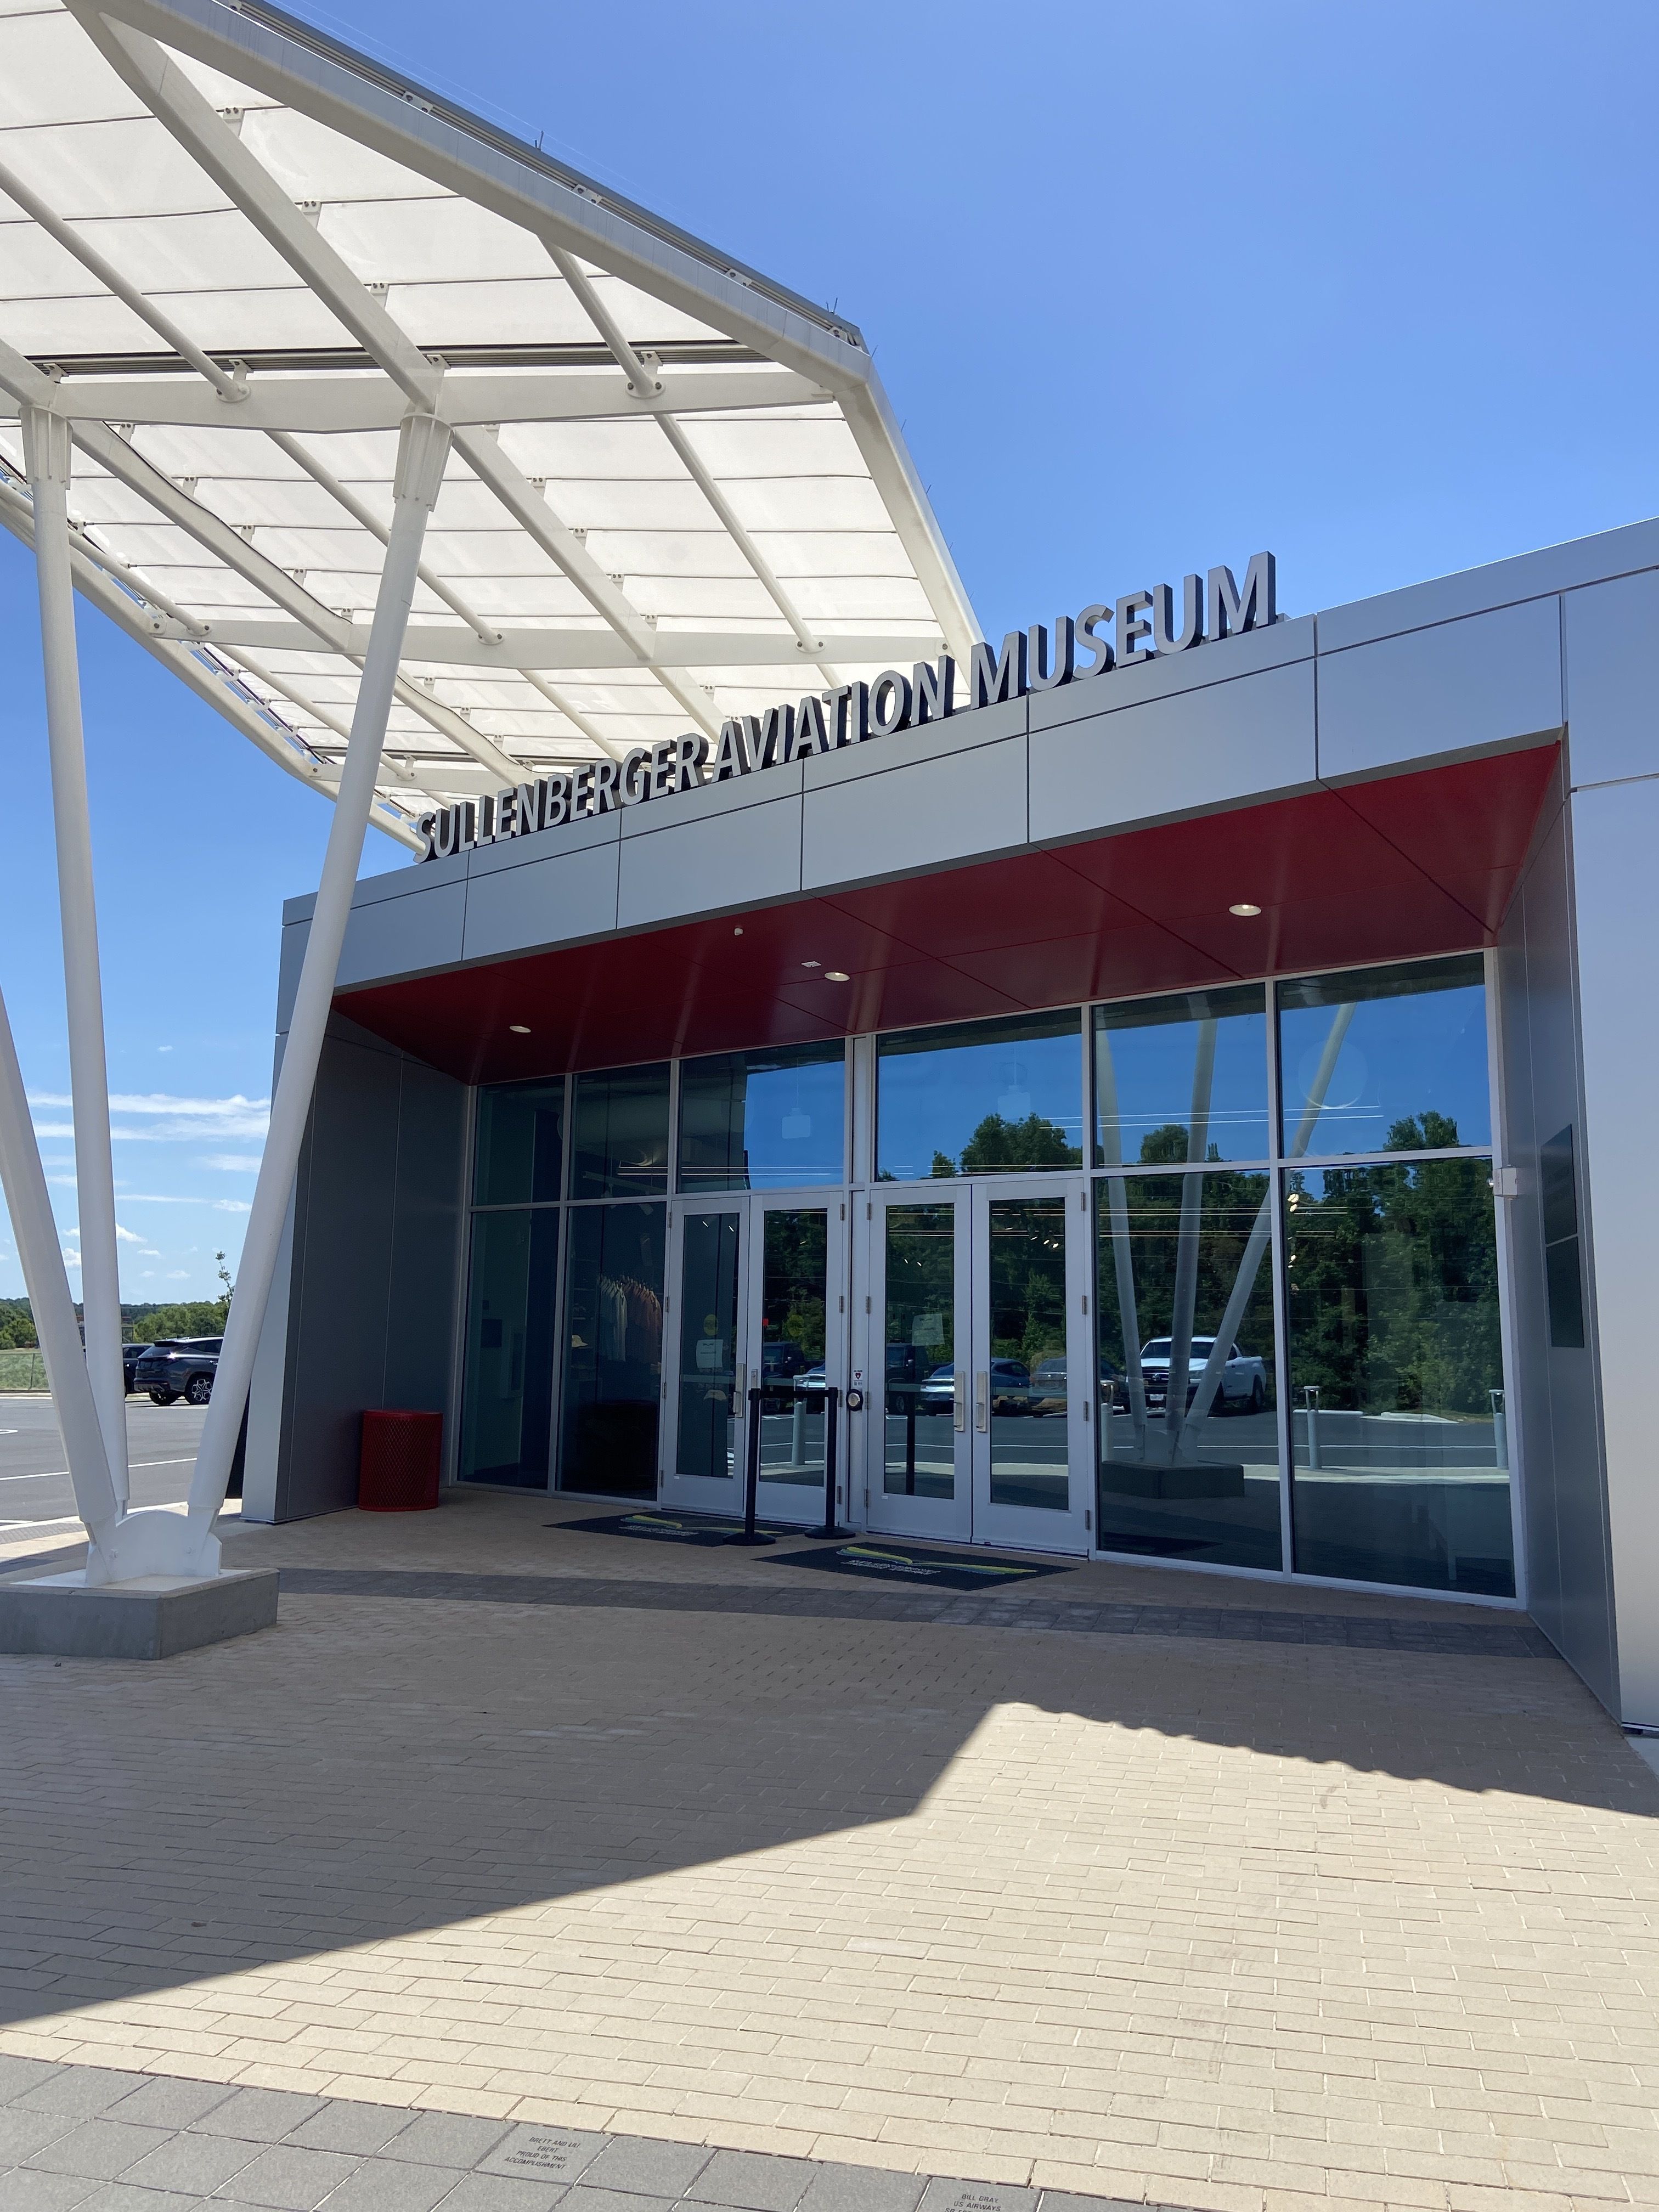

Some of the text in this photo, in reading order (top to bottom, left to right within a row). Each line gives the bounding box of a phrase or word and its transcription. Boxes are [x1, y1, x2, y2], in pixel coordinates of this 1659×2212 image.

[414, 551, 1276, 864] SULLENBERGER AVIATION MUSEUM
[504, 2157, 566, 2169] ACCOMPLISHMENT
[966, 2203, 1001, 2211] AIRWAYS
